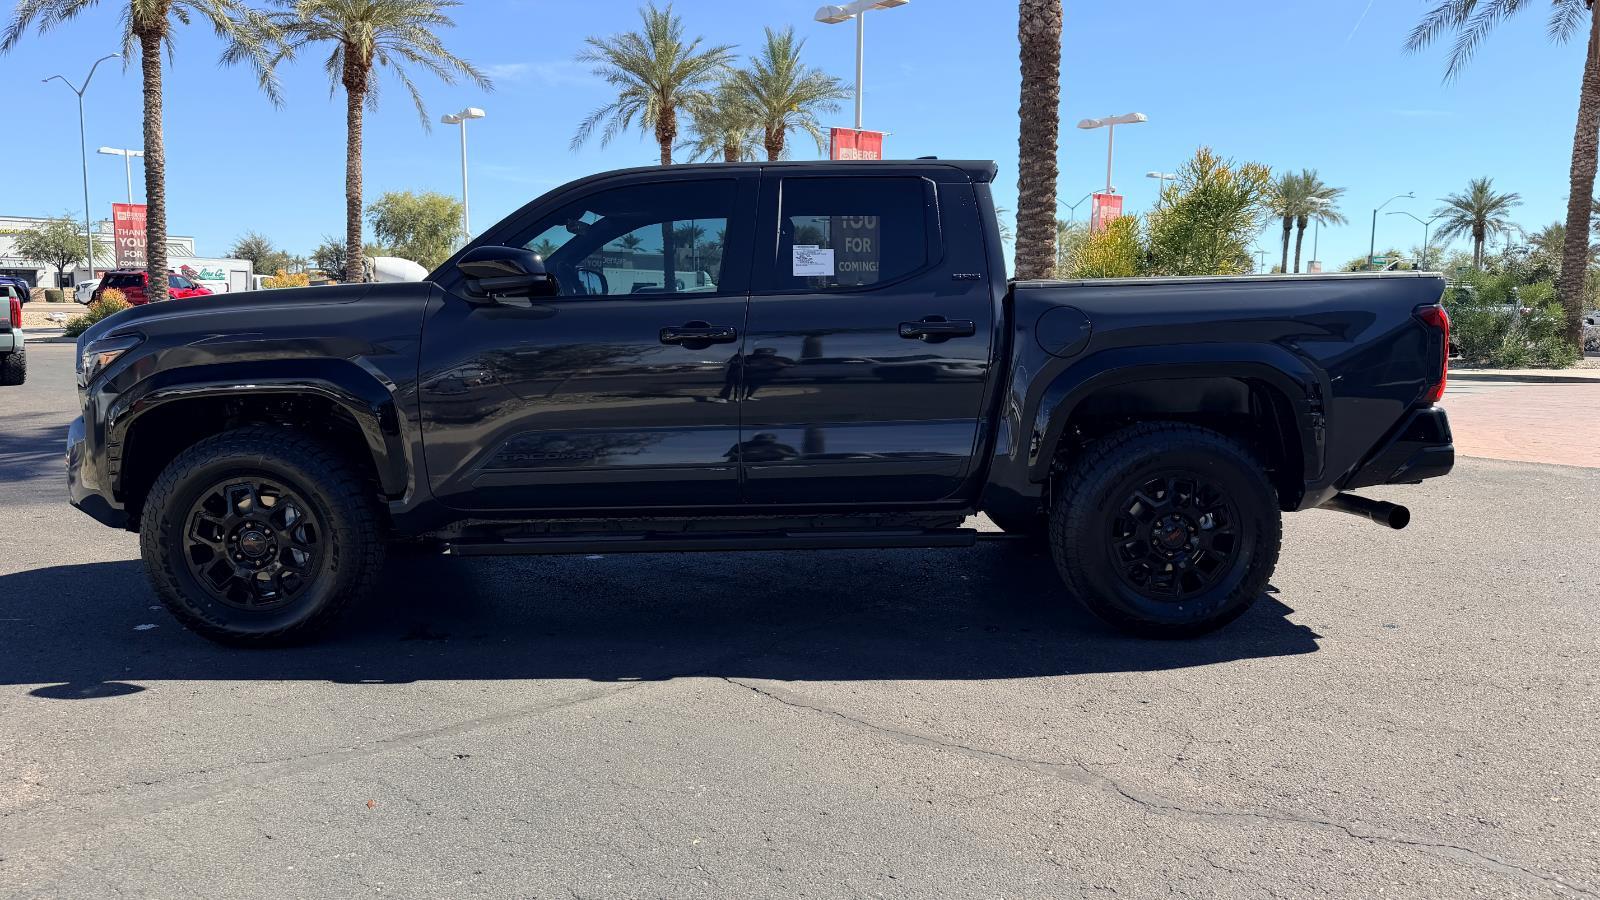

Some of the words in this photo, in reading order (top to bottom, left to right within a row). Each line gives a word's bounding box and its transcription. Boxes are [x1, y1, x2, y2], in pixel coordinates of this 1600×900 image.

[852, 147, 878, 160] BERGE
[119, 237, 146, 247] YOU
[845, 237, 871, 252] FOR
[124, 250, 143, 258] FOR
[838, 261, 879, 272] COMING!
[497, 451, 593, 461] TACOMA
